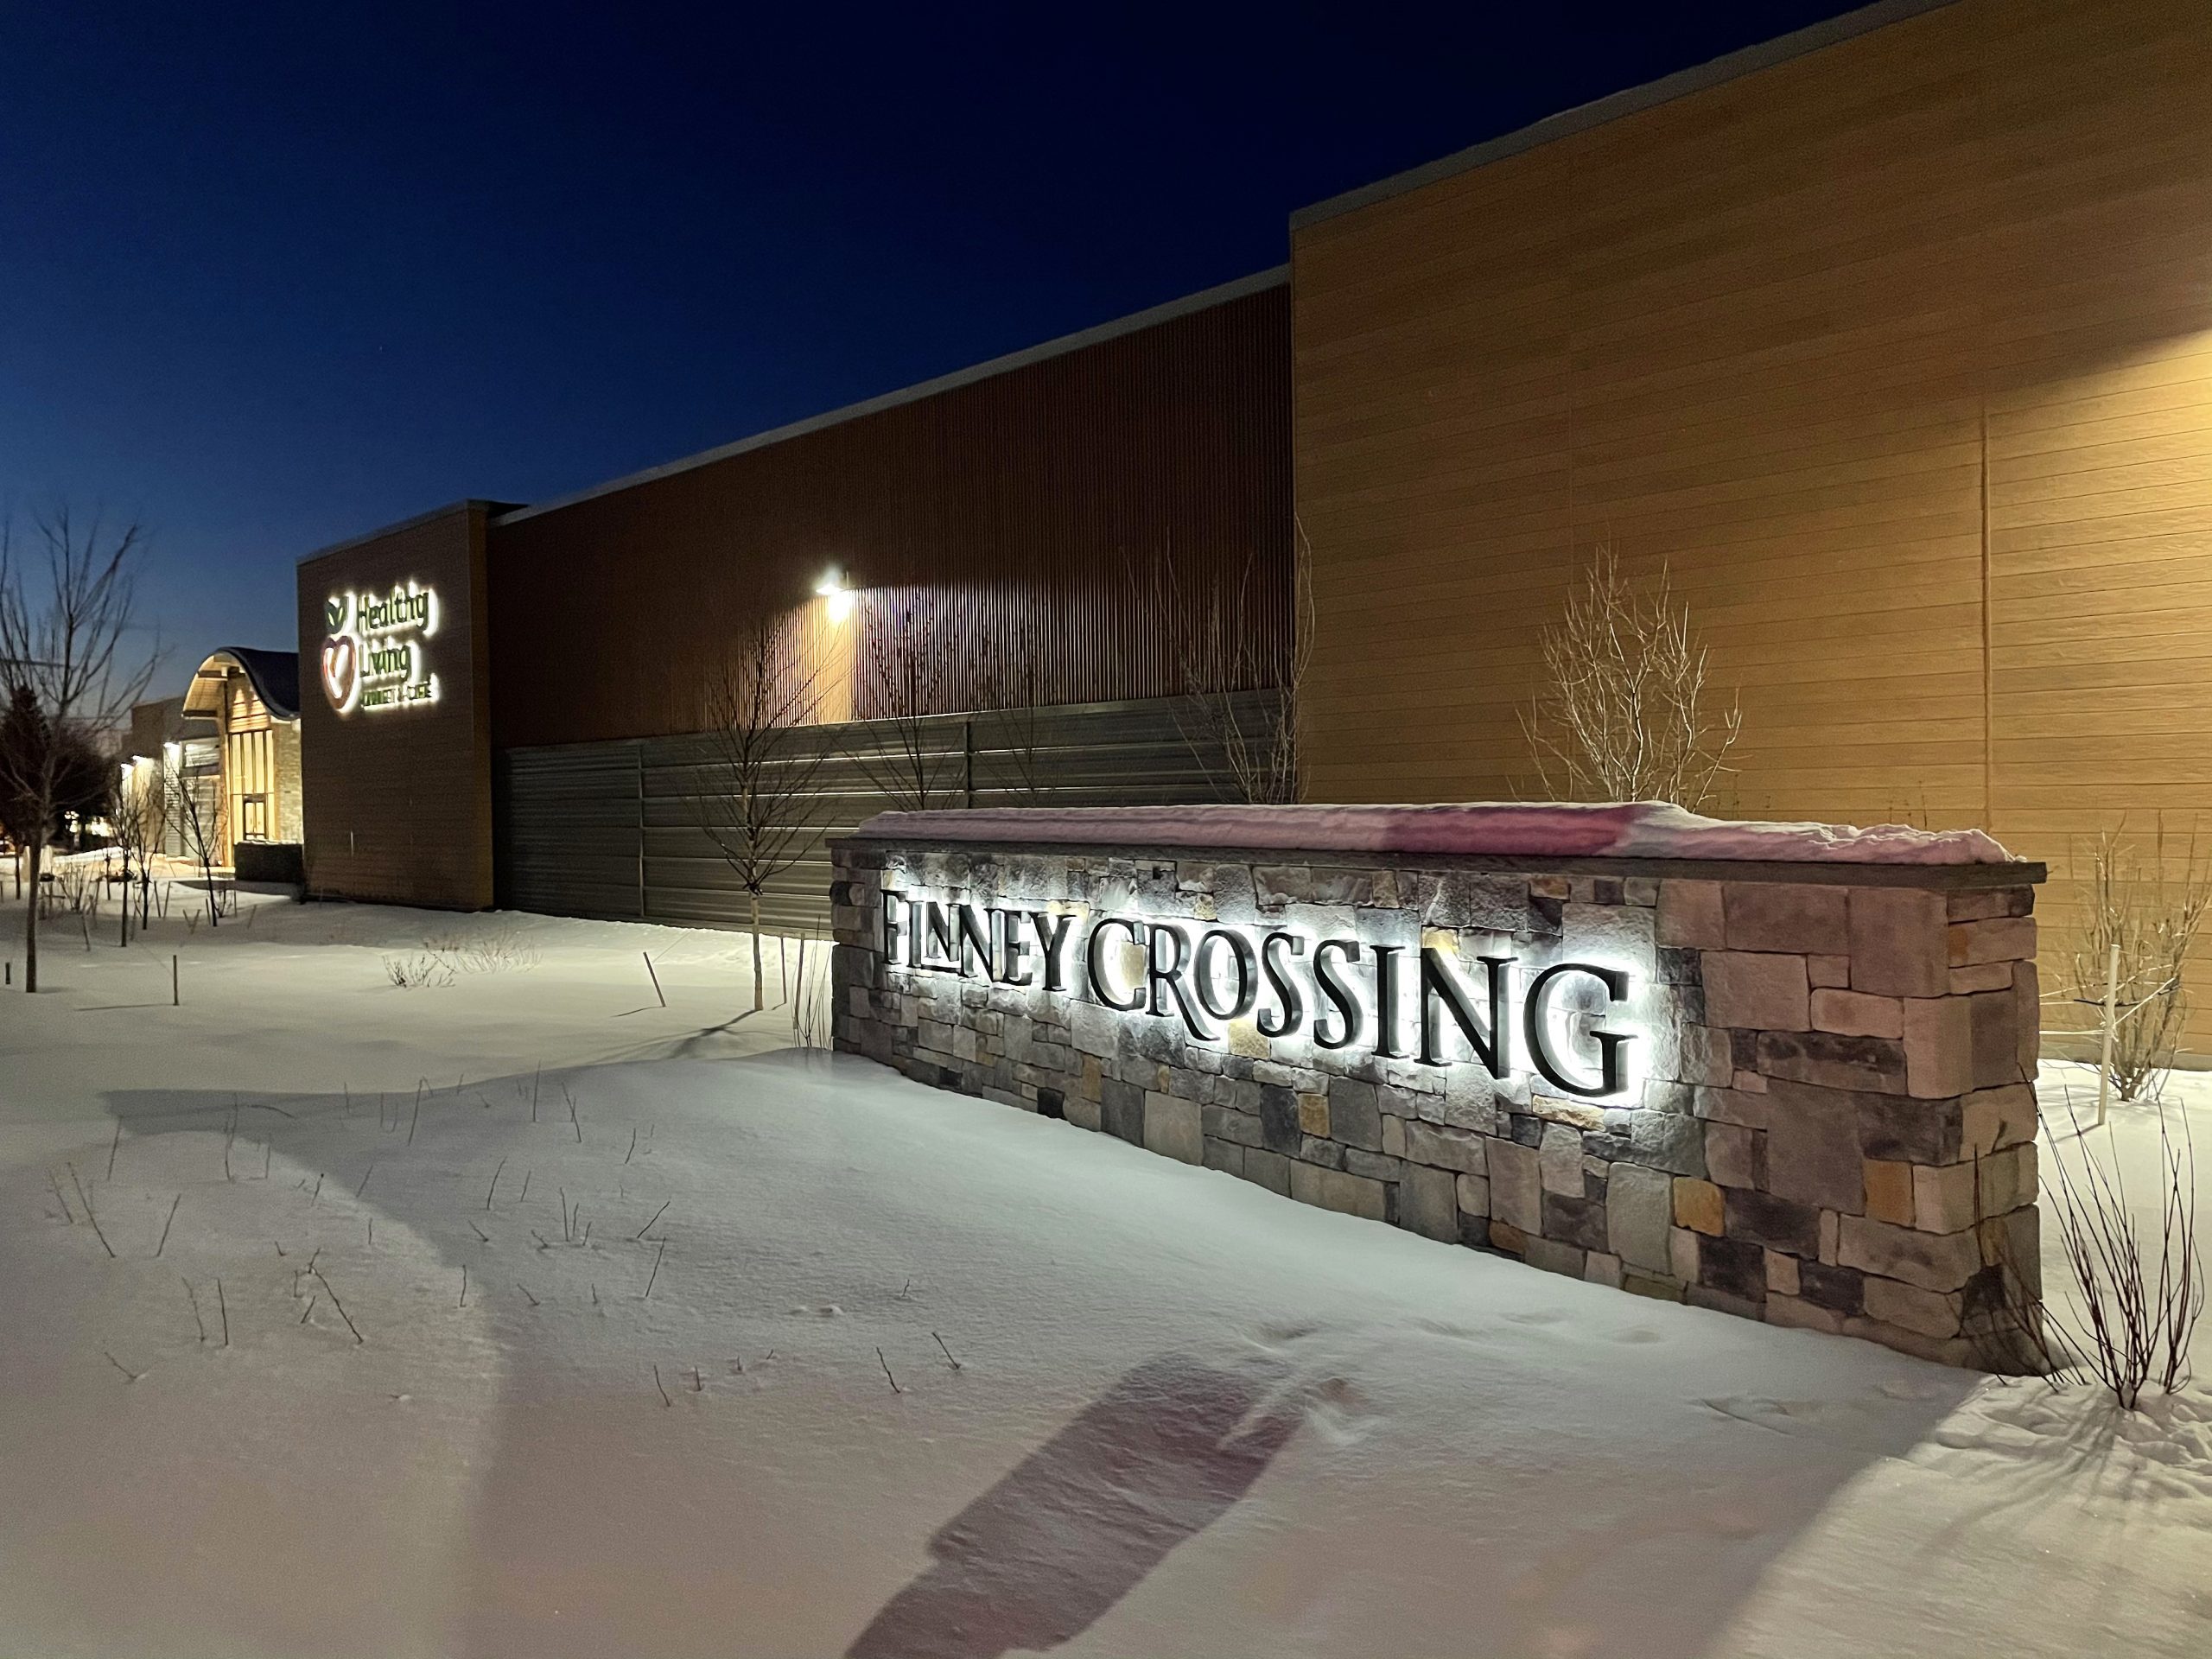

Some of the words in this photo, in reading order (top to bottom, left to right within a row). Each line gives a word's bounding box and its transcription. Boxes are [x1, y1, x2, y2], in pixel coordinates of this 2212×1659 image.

[359, 640, 411, 681] Living
[880, 889, 1077, 991] FINNEY
[1087, 918, 1638, 1098] CROSSING
